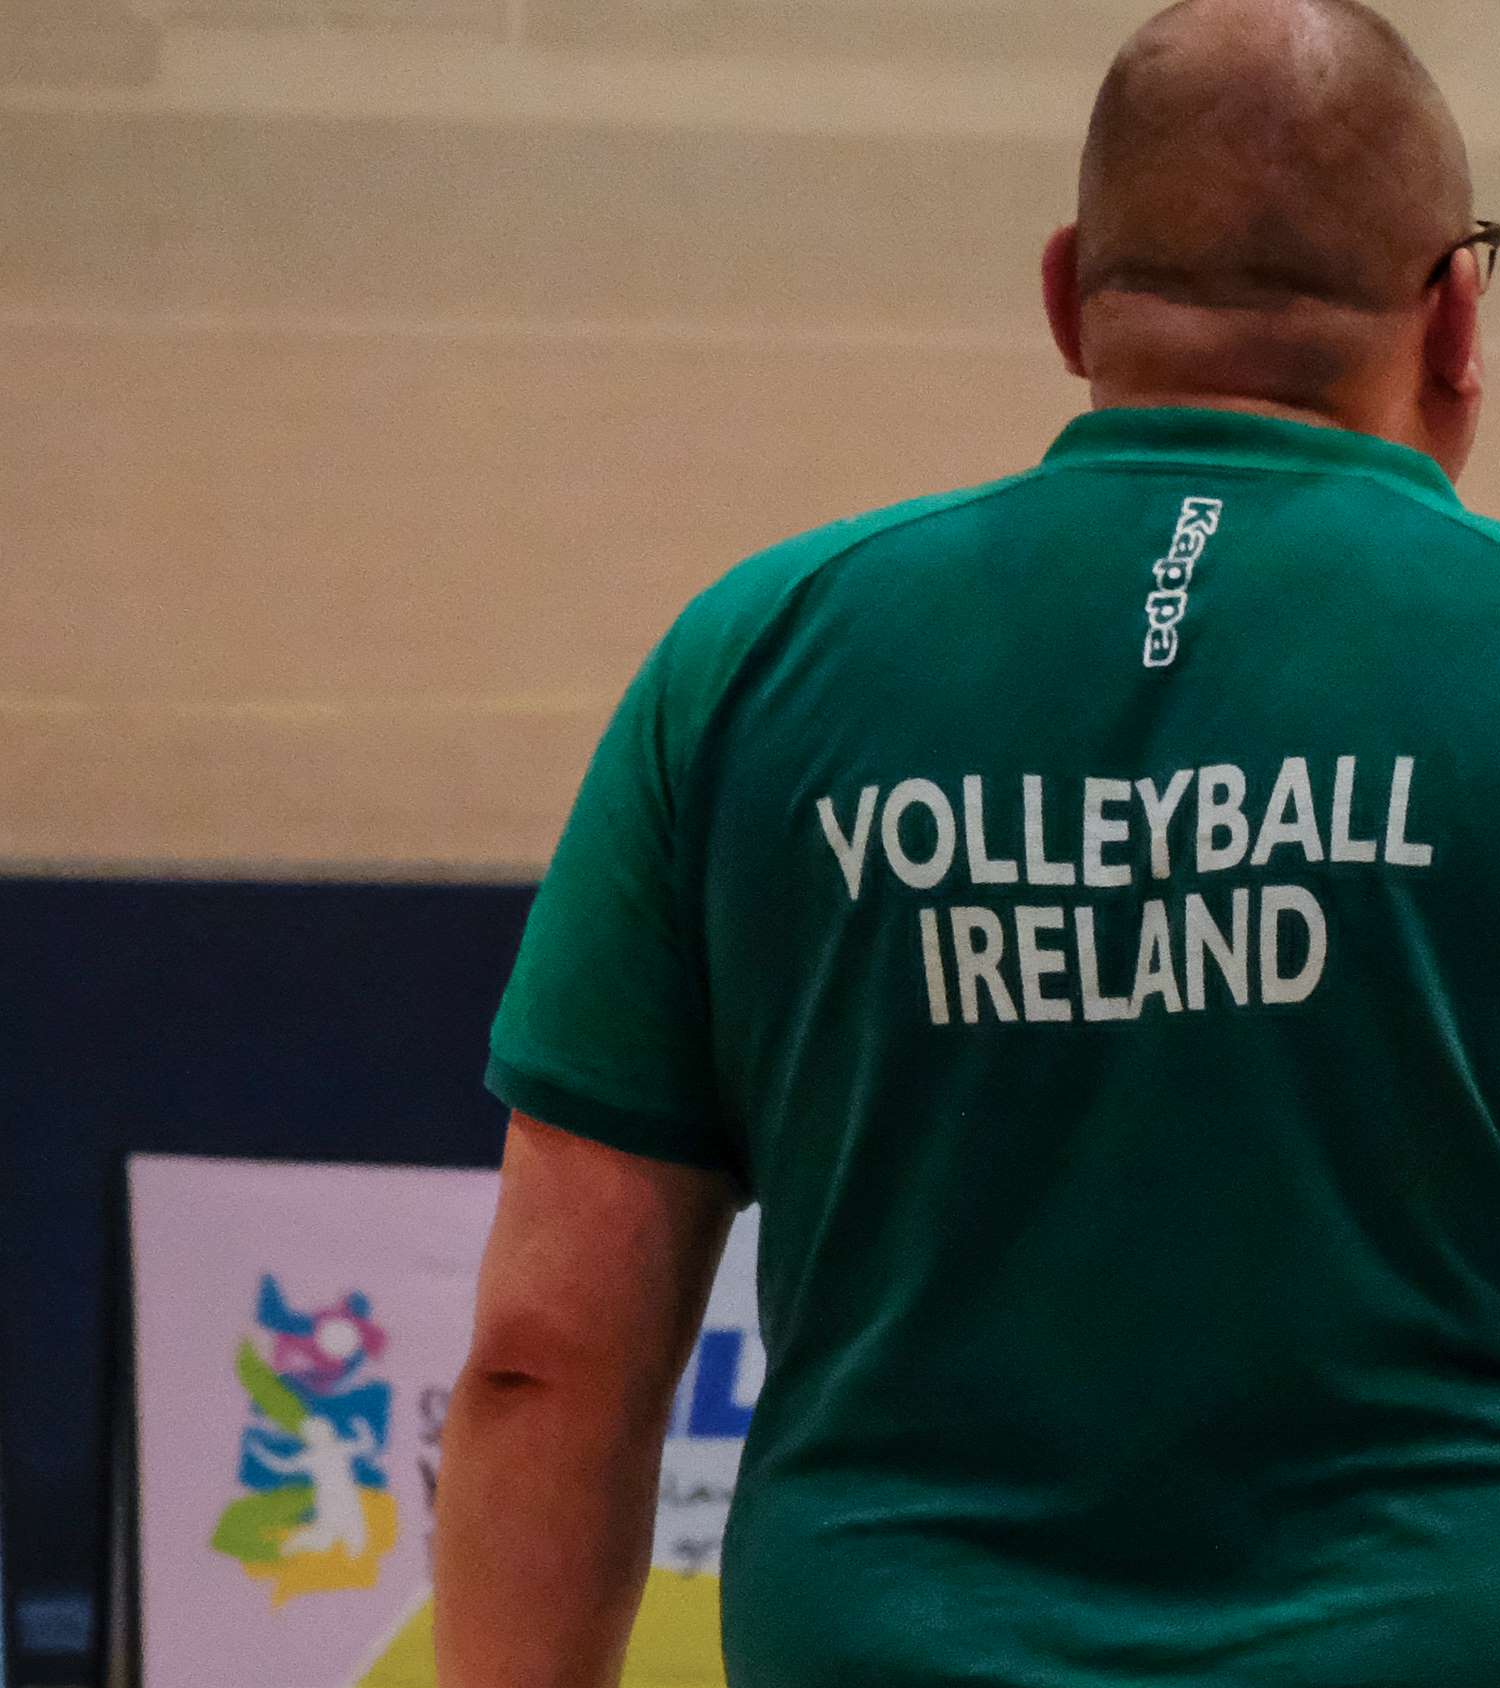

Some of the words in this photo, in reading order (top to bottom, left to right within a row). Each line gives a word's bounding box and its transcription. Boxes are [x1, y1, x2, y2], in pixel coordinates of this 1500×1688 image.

[1143, 497, 1223, 668] Kappa
[816, 755, 1434, 900] VOLLEYBALL
[918, 884, 1328, 1025] IRELAND
